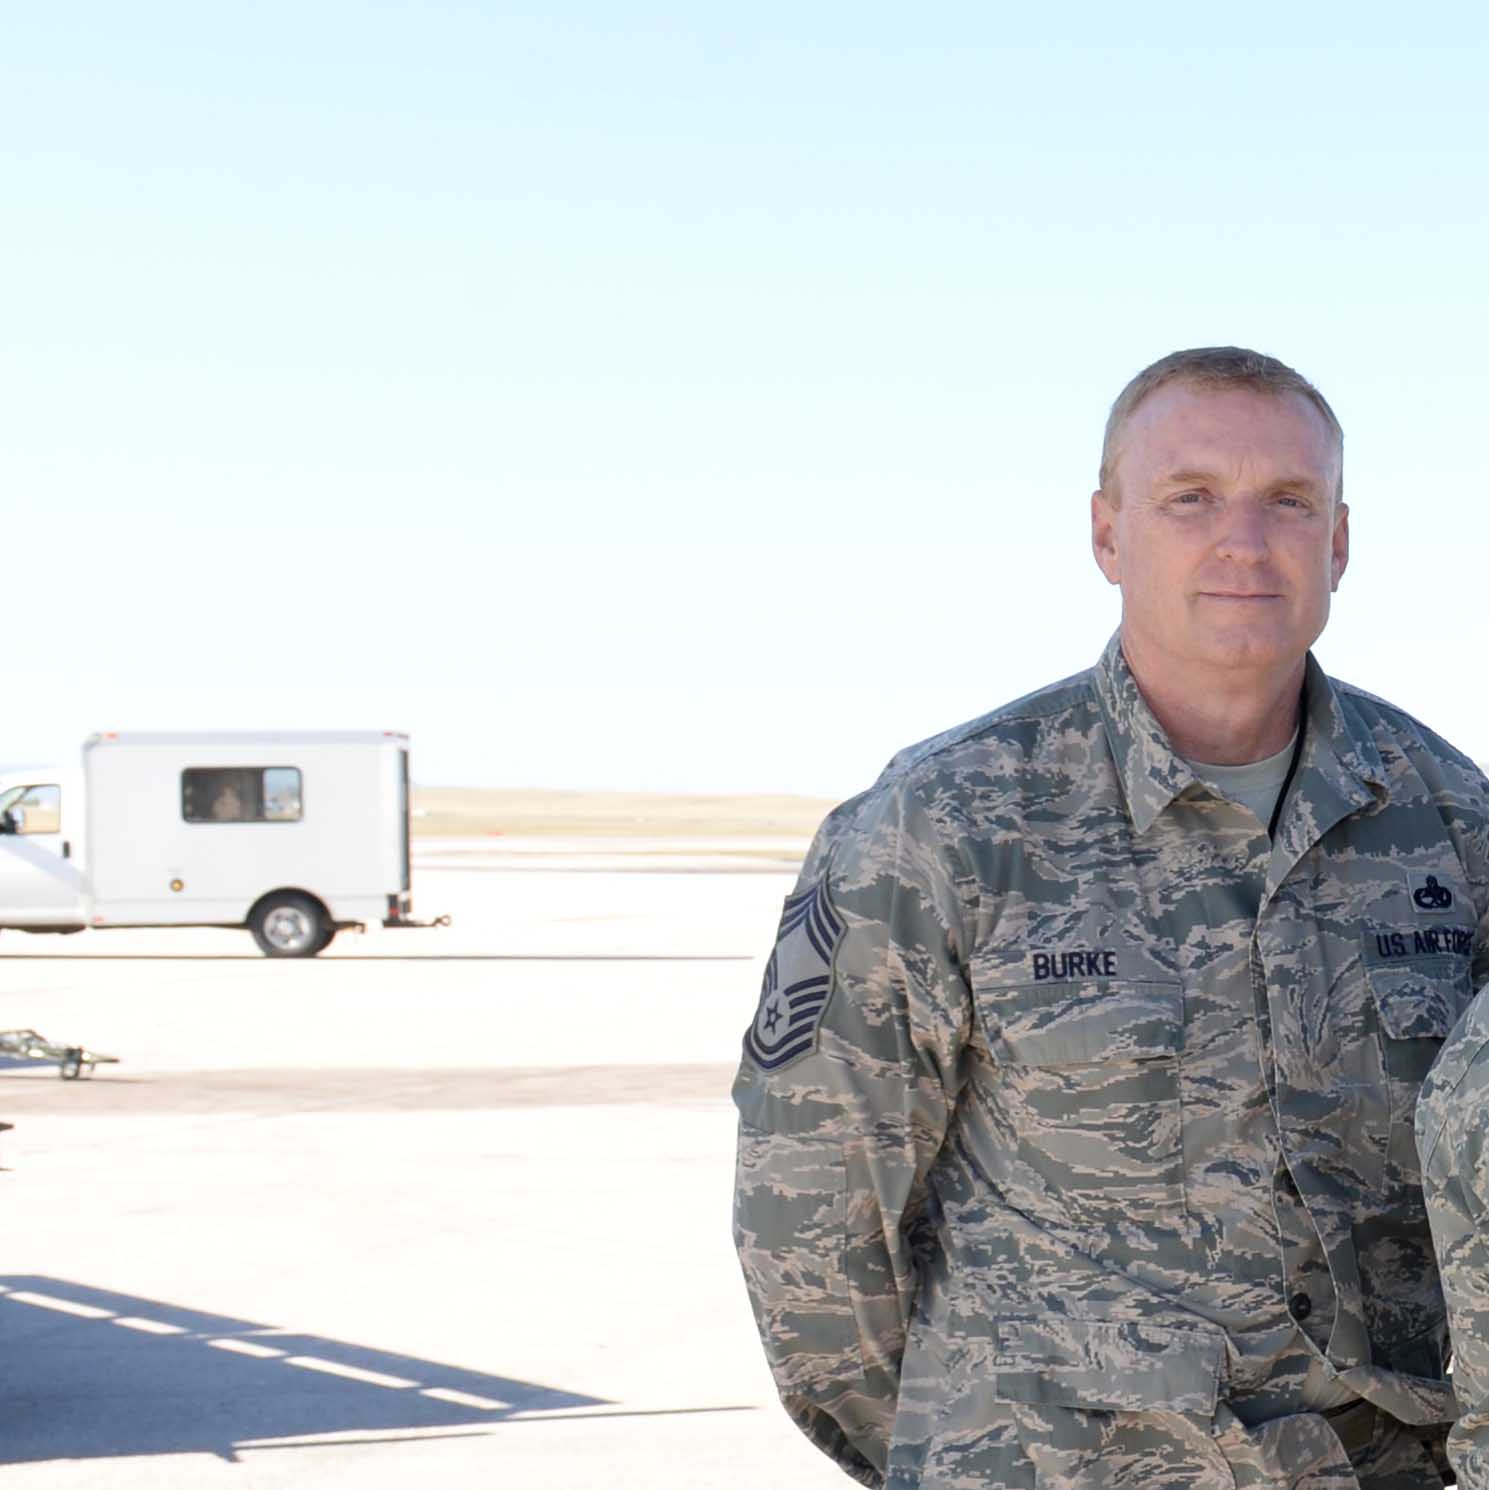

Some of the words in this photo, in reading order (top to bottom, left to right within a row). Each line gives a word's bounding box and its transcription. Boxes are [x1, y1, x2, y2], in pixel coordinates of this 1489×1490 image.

[1413, 928, 1442, 954] AIR
[1442, 926, 1474, 956] FOR
[1033, 951, 1118, 980] BURKE
